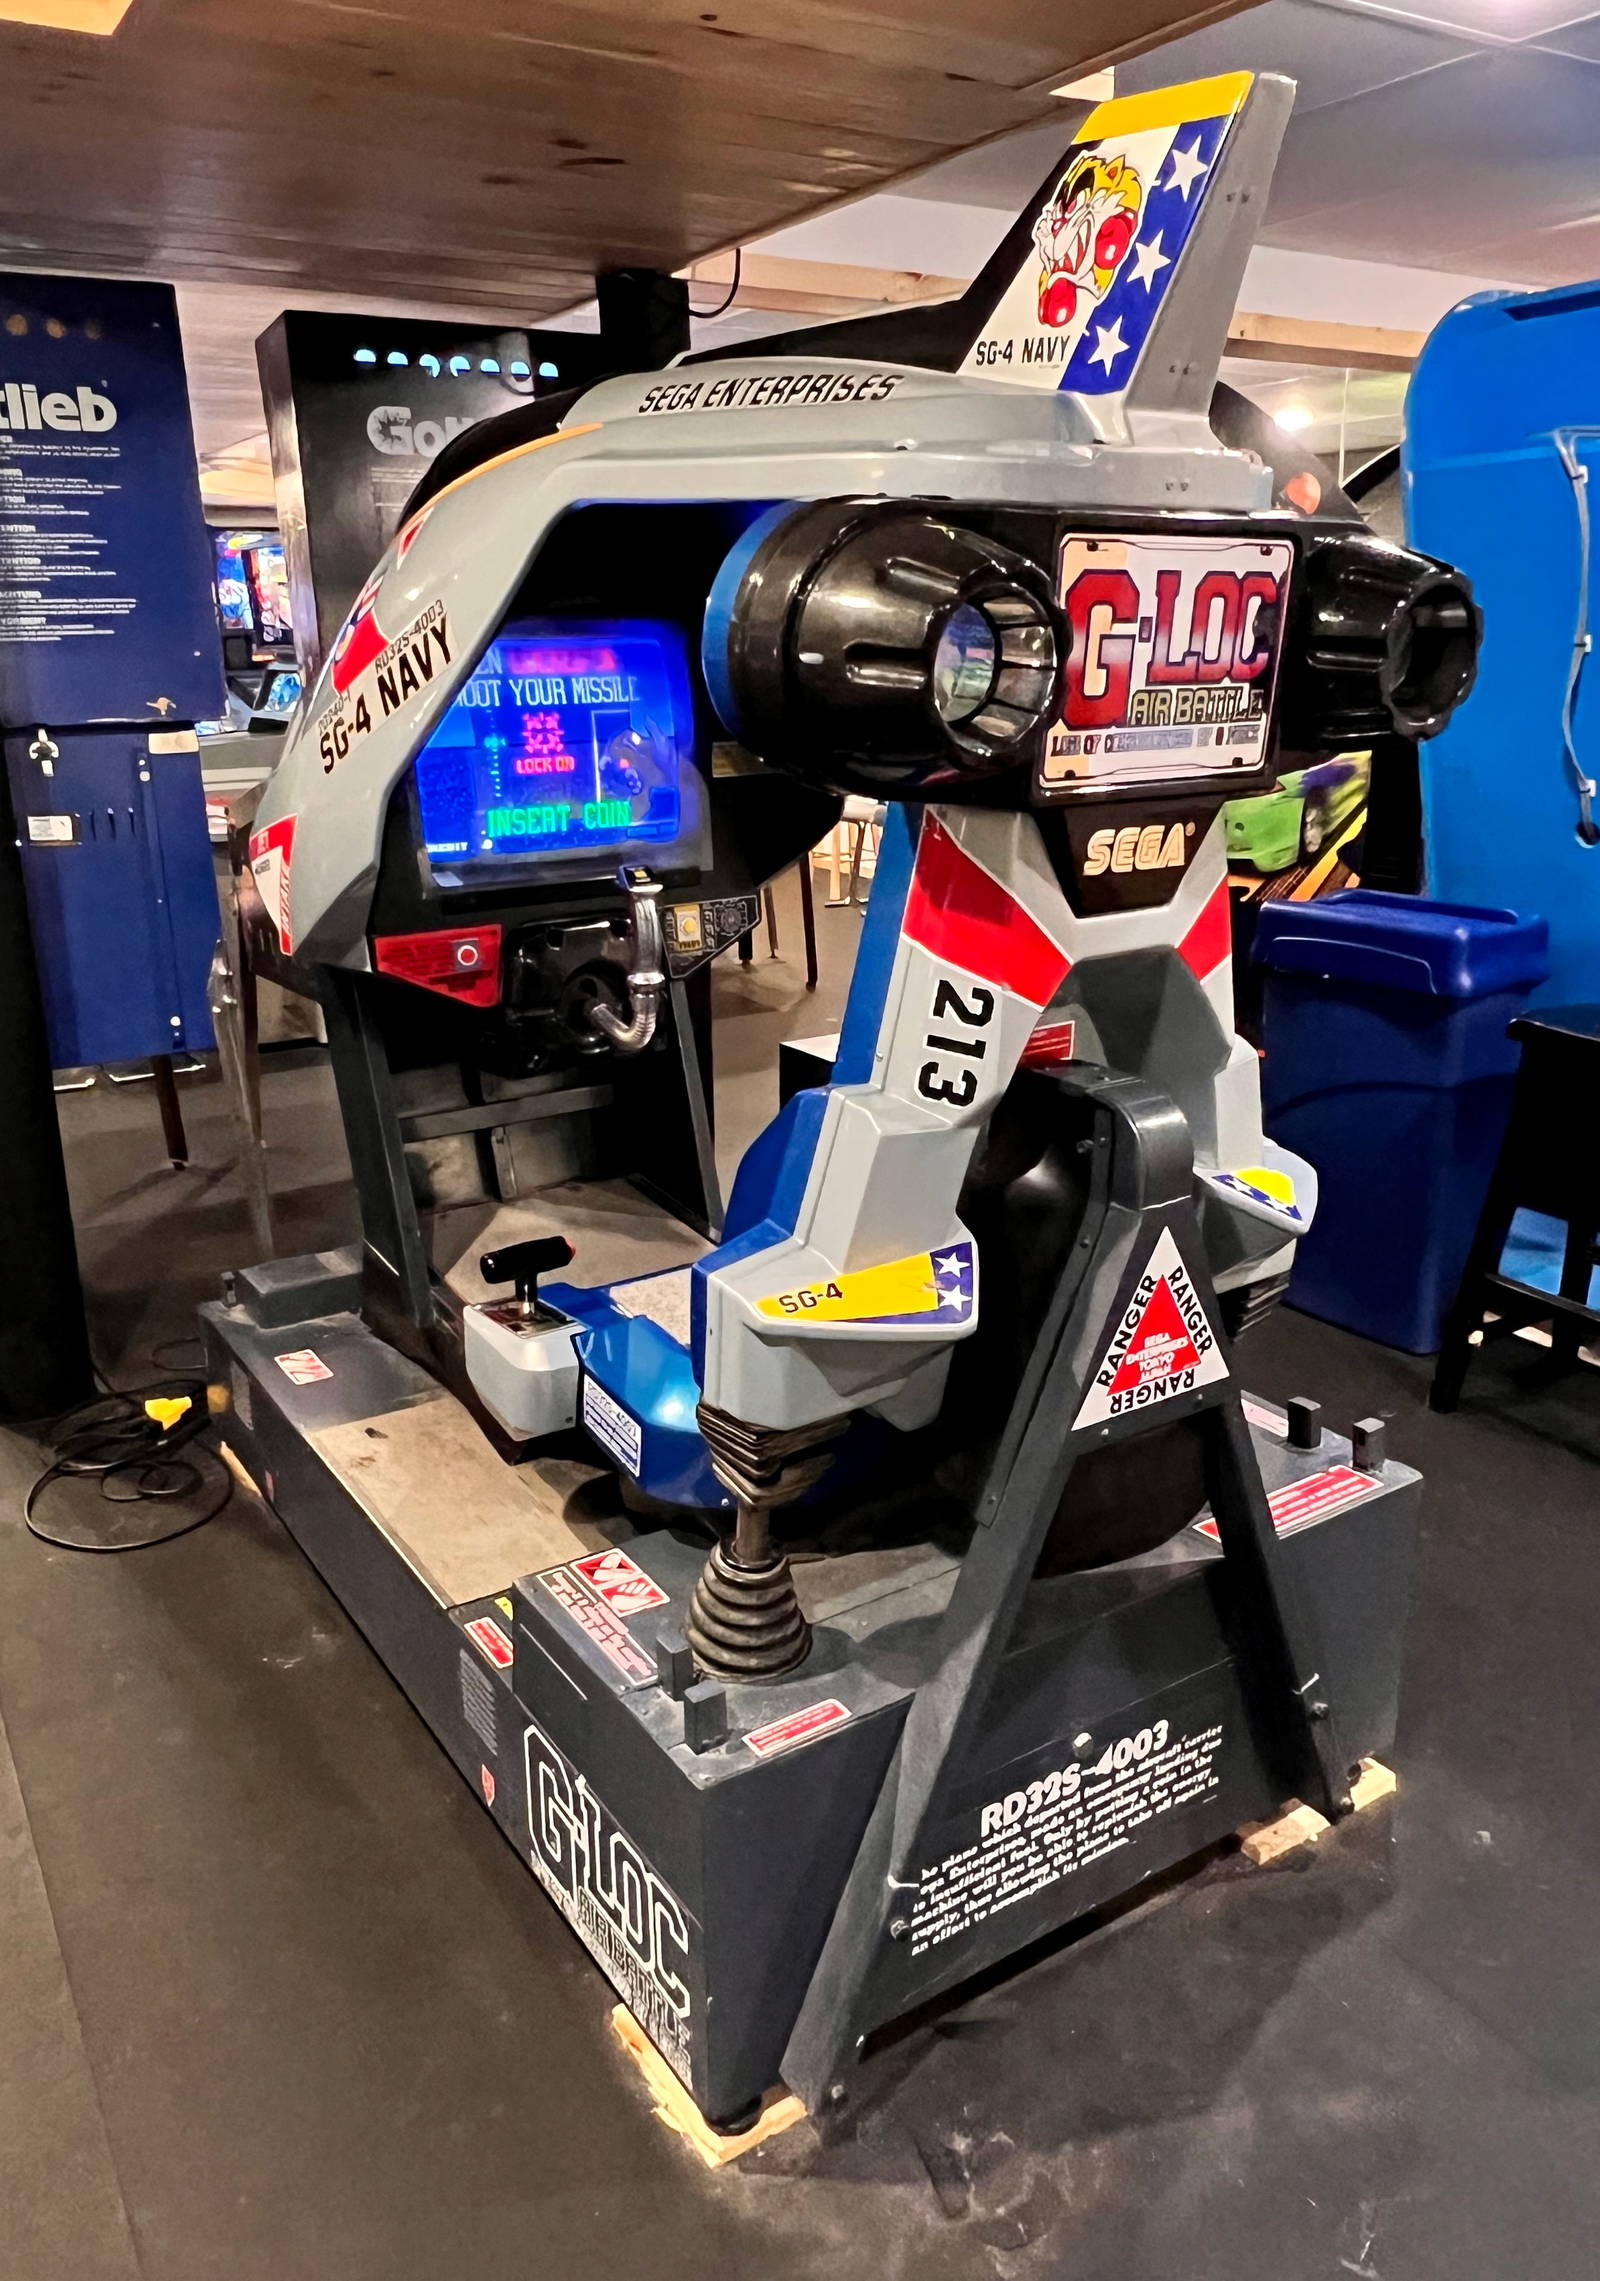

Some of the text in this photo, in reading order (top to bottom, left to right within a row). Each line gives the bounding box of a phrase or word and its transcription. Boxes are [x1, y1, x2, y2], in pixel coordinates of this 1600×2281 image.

[976, 335, 1070, 366] SG-4 NAVY
[638, 374, 904, 413] SEGA ENTERPRISES
[1064, 568, 1278, 731] G-LOC
[319, 693, 371, 774] SG-4
[376, 611, 451, 717] NAVY
[509, 678, 567, 706] YOUR
[1128, 687, 1264, 727] AIR BATTLE
[516, 755, 575, 775] LOCK ON
[486, 800, 633, 838] INSERT COIN
[1083, 822, 1186, 876] SEGA
[918, 980, 995, 1107] 213
[778, 1282, 844, 1314] SG-4
[1167, 1265, 1213, 1357] RANGER
[1096, 1274, 1157, 1388] RANGER
[1109, 1368, 1195, 1414] RANGER
[981, 1719, 1169, 1838] RD32S-4003
[921, 1867, 938, 1881] he
